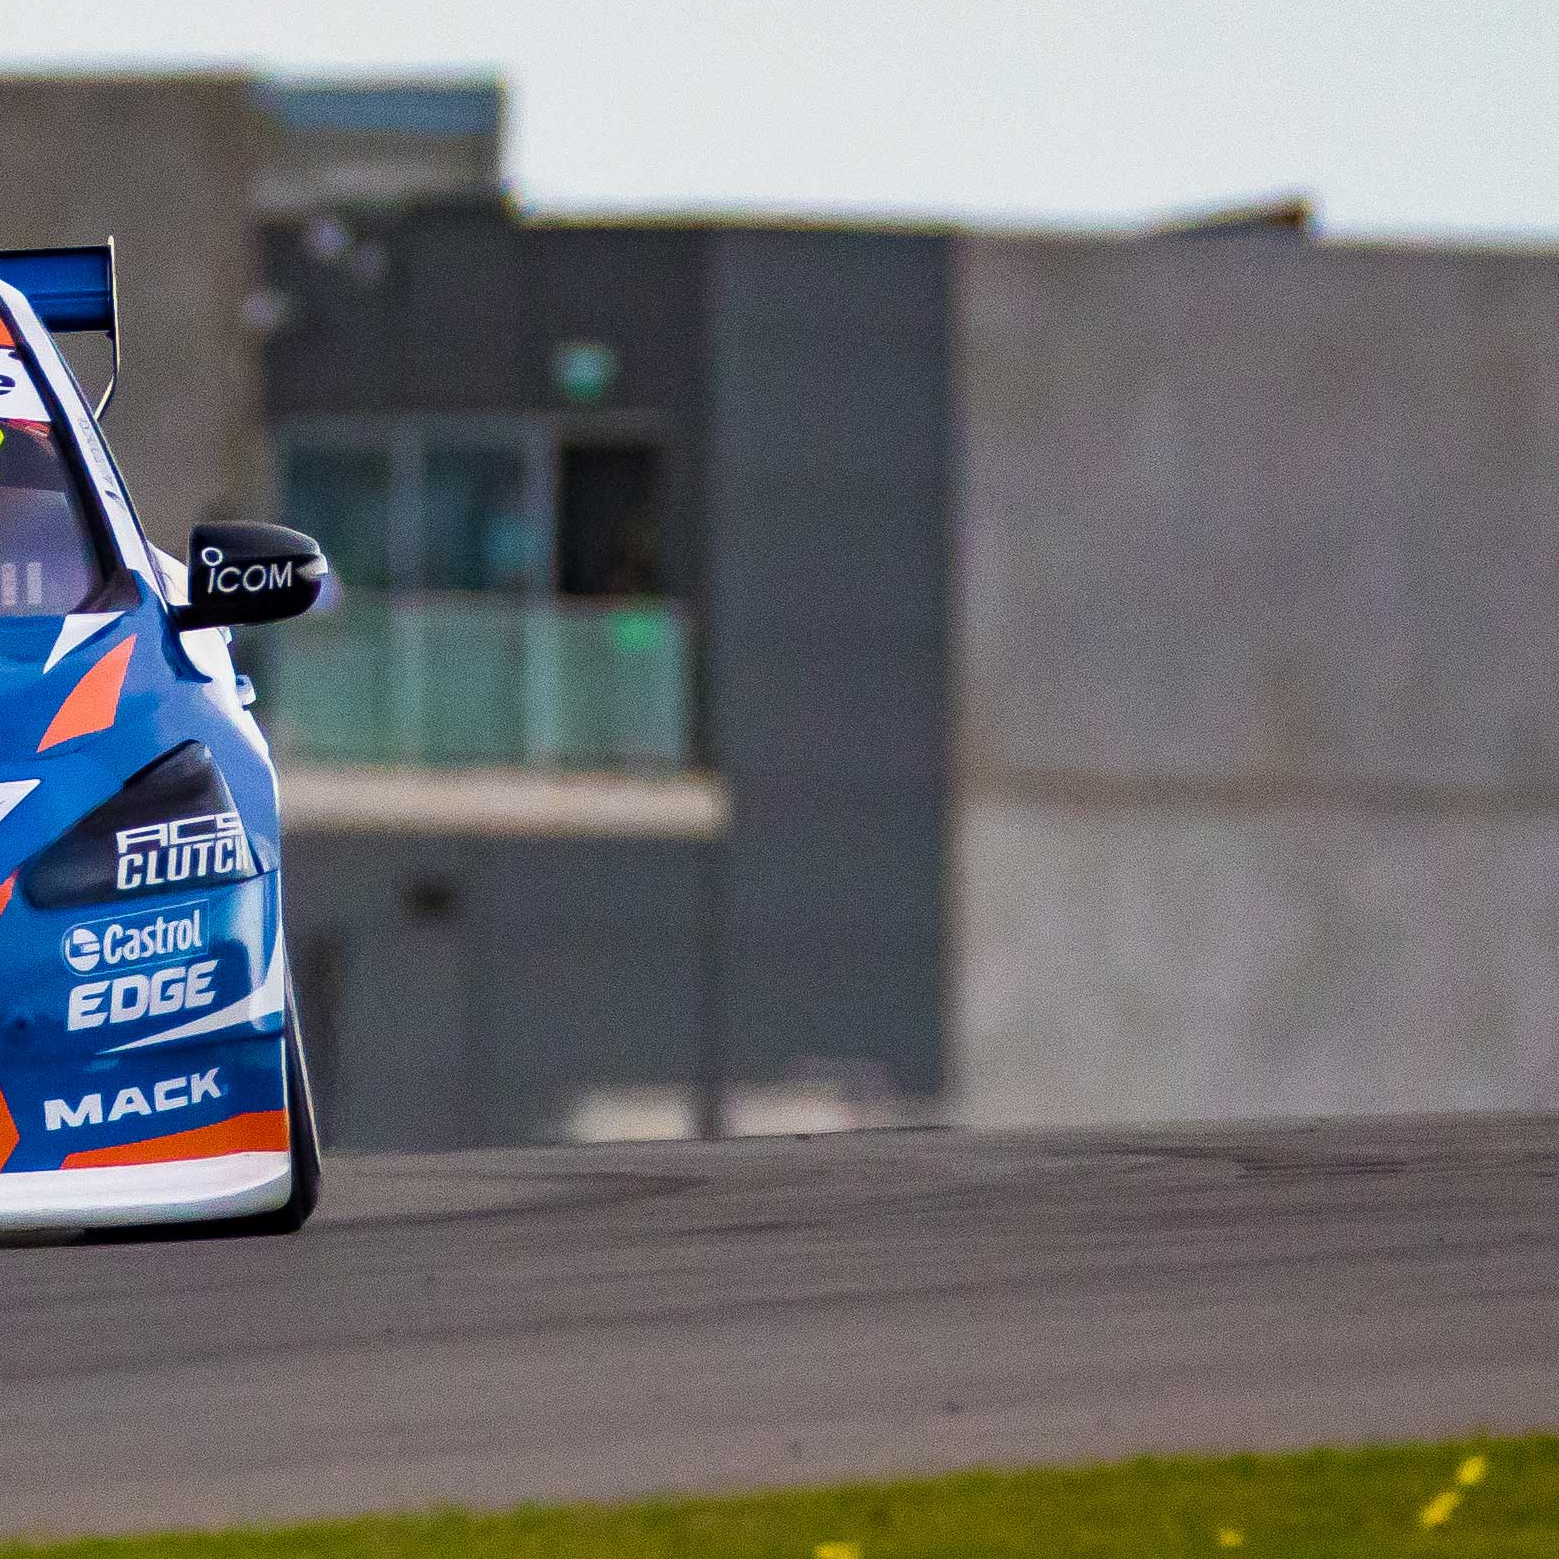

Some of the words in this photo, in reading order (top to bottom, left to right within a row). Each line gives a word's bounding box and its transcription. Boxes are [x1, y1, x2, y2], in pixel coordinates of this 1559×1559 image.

[116, 812, 244, 854] ACS
[103, 908, 203, 965] Castrol
[67, 959, 219, 1031] EDGE
[43, 1067, 223, 1131] MACK
